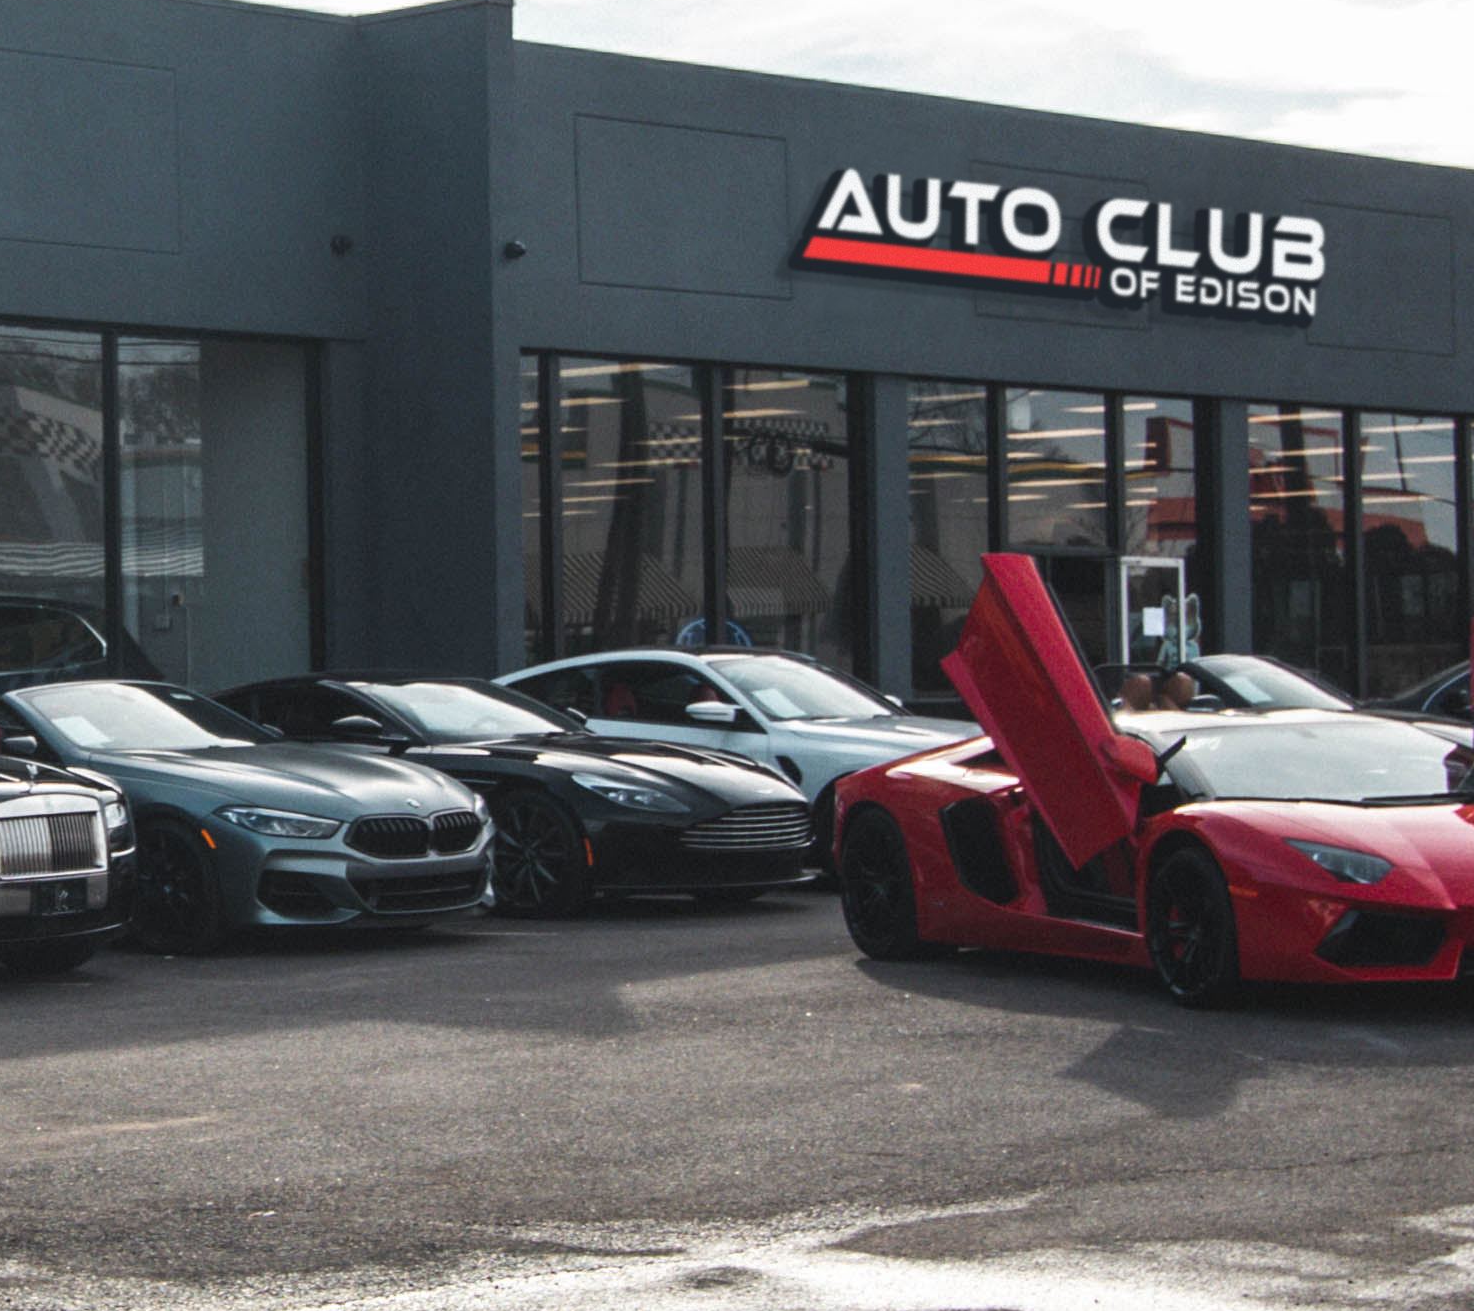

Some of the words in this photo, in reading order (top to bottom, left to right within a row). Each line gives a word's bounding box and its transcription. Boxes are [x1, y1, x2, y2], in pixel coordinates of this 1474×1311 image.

[817, 168, 1062, 252] AUTO
[1096, 198, 1326, 281] CLUB
[1110, 267, 1161, 298] OF
[1174, 275, 1317, 317] EDISON
